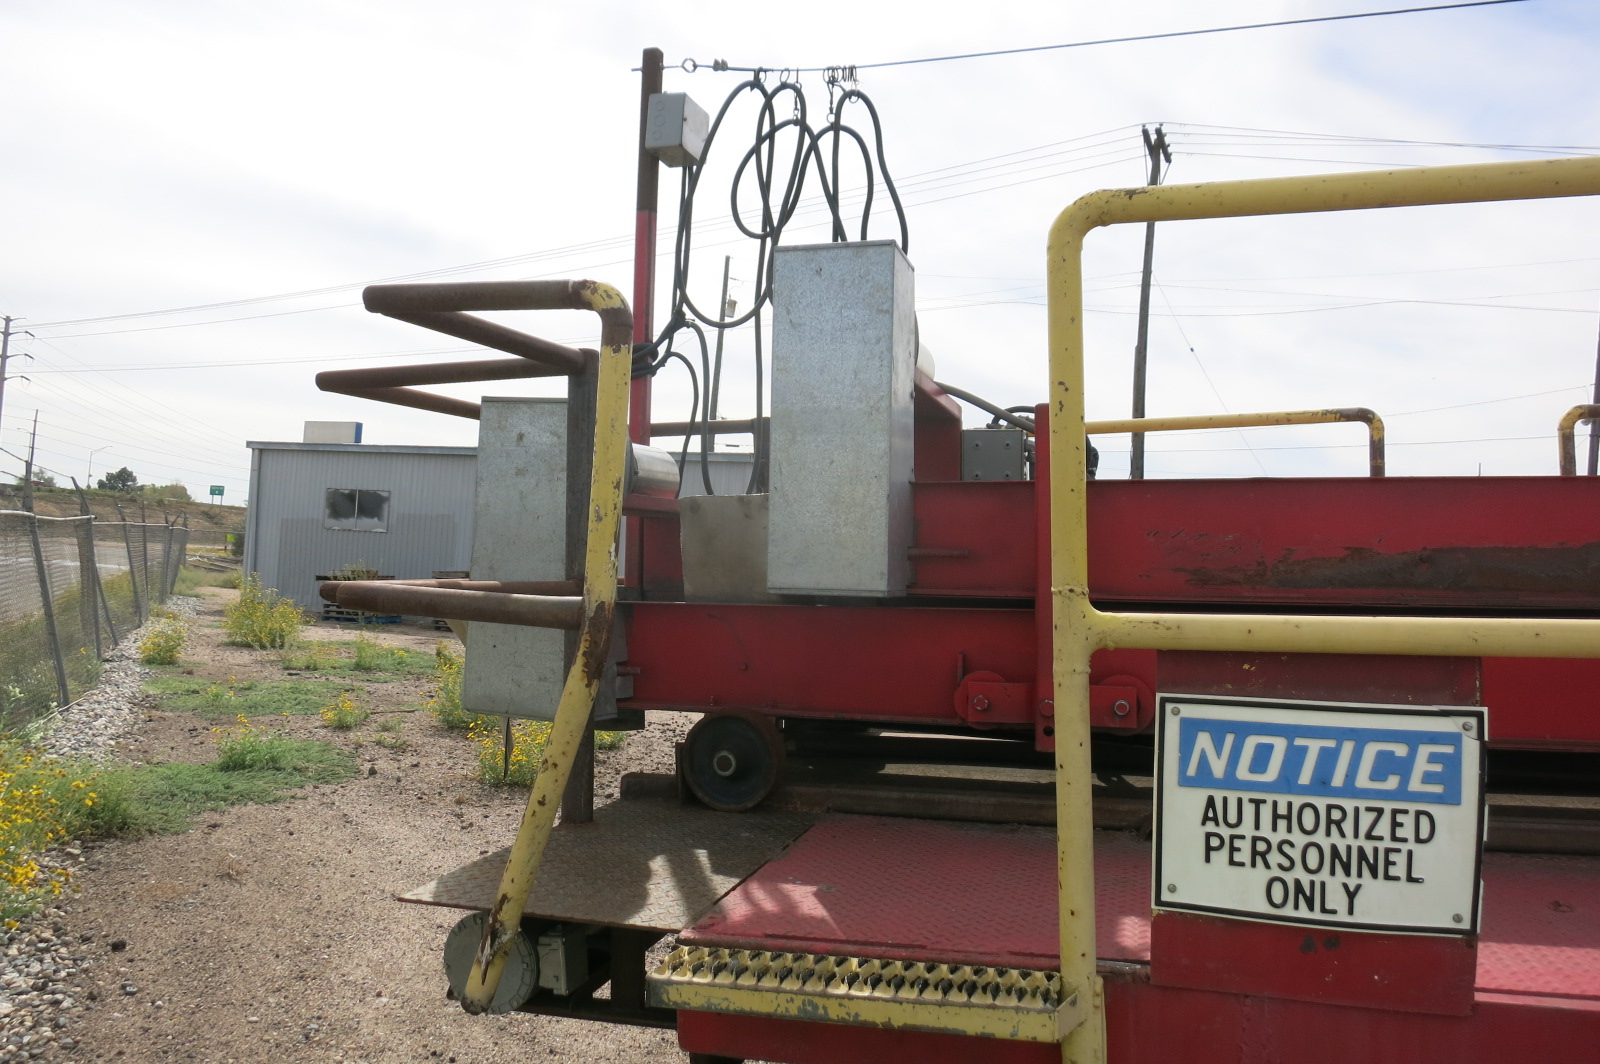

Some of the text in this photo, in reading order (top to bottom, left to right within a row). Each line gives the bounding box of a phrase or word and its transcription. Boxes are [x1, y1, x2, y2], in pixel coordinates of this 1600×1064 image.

[1186, 731, 1455, 793] NOTICE
[1201, 794, 1436, 843] AUTHORIZED
[1204, 831, 1424, 883] PERSONNEL
[1265, 876, 1362, 915] ONLY
